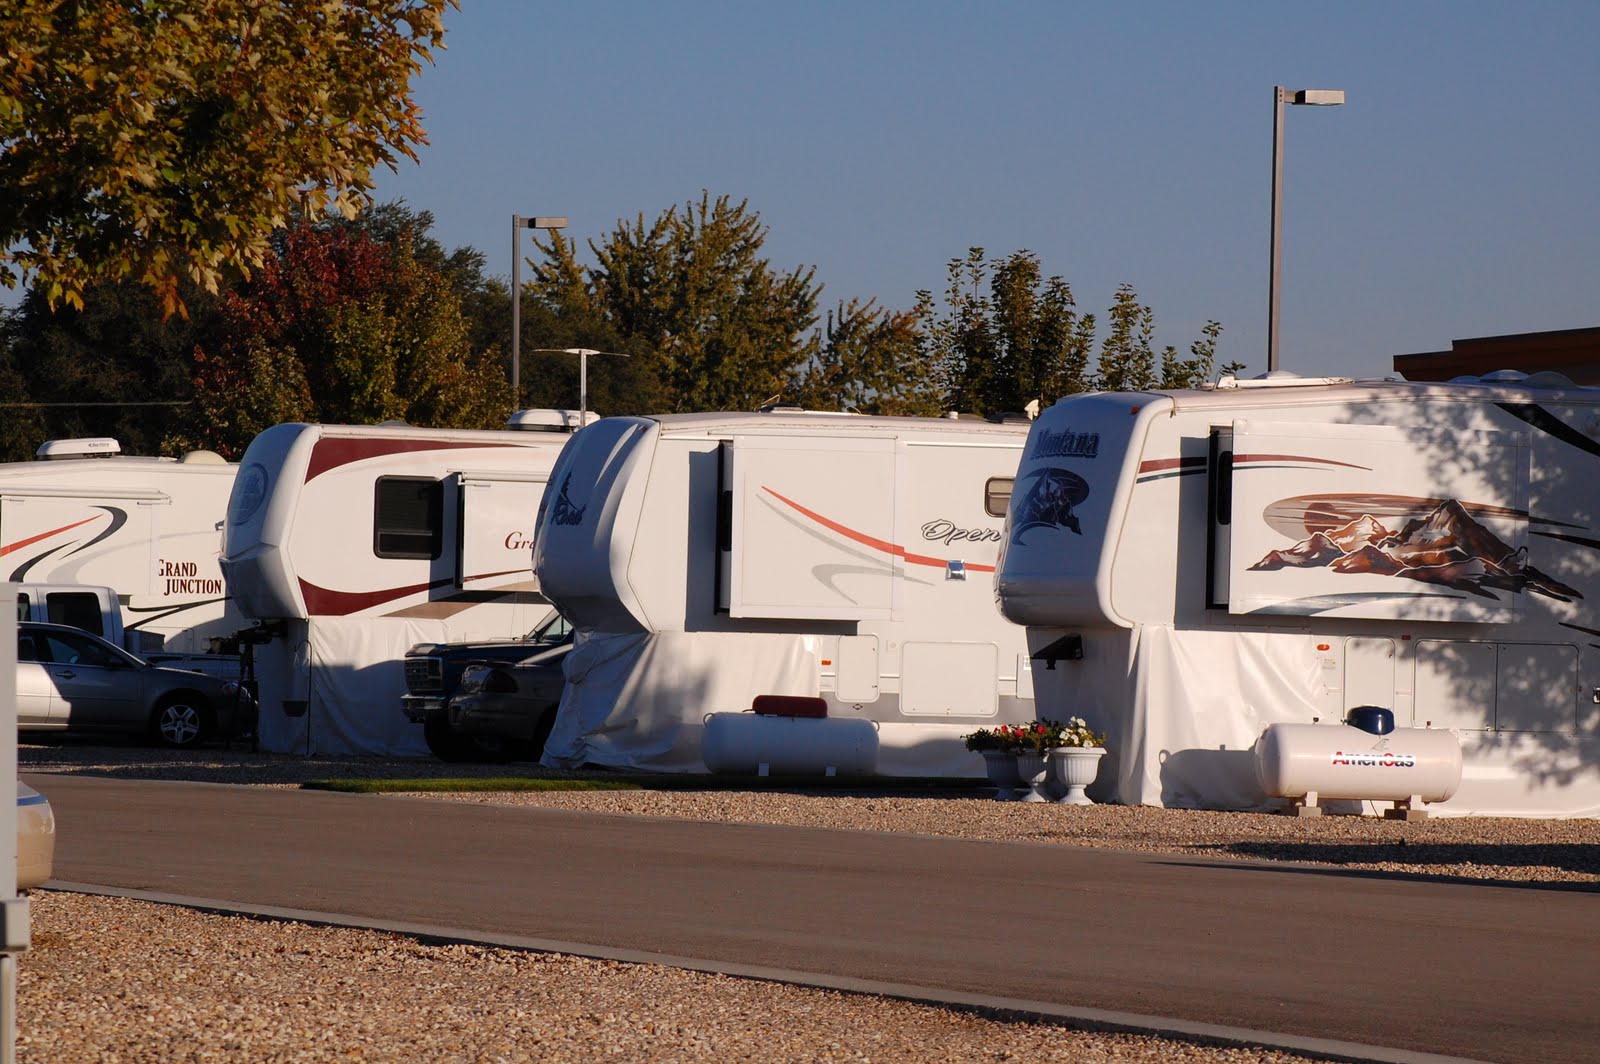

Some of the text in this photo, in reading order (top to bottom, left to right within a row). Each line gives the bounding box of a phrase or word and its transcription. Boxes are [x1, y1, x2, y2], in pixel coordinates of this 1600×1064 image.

[1031, 426, 1099, 458] Montana
[921, 519, 1001, 546] Open
[164, 579, 222, 596] JUNCTION
[1332, 751, 1415, 768] AmeriGas
